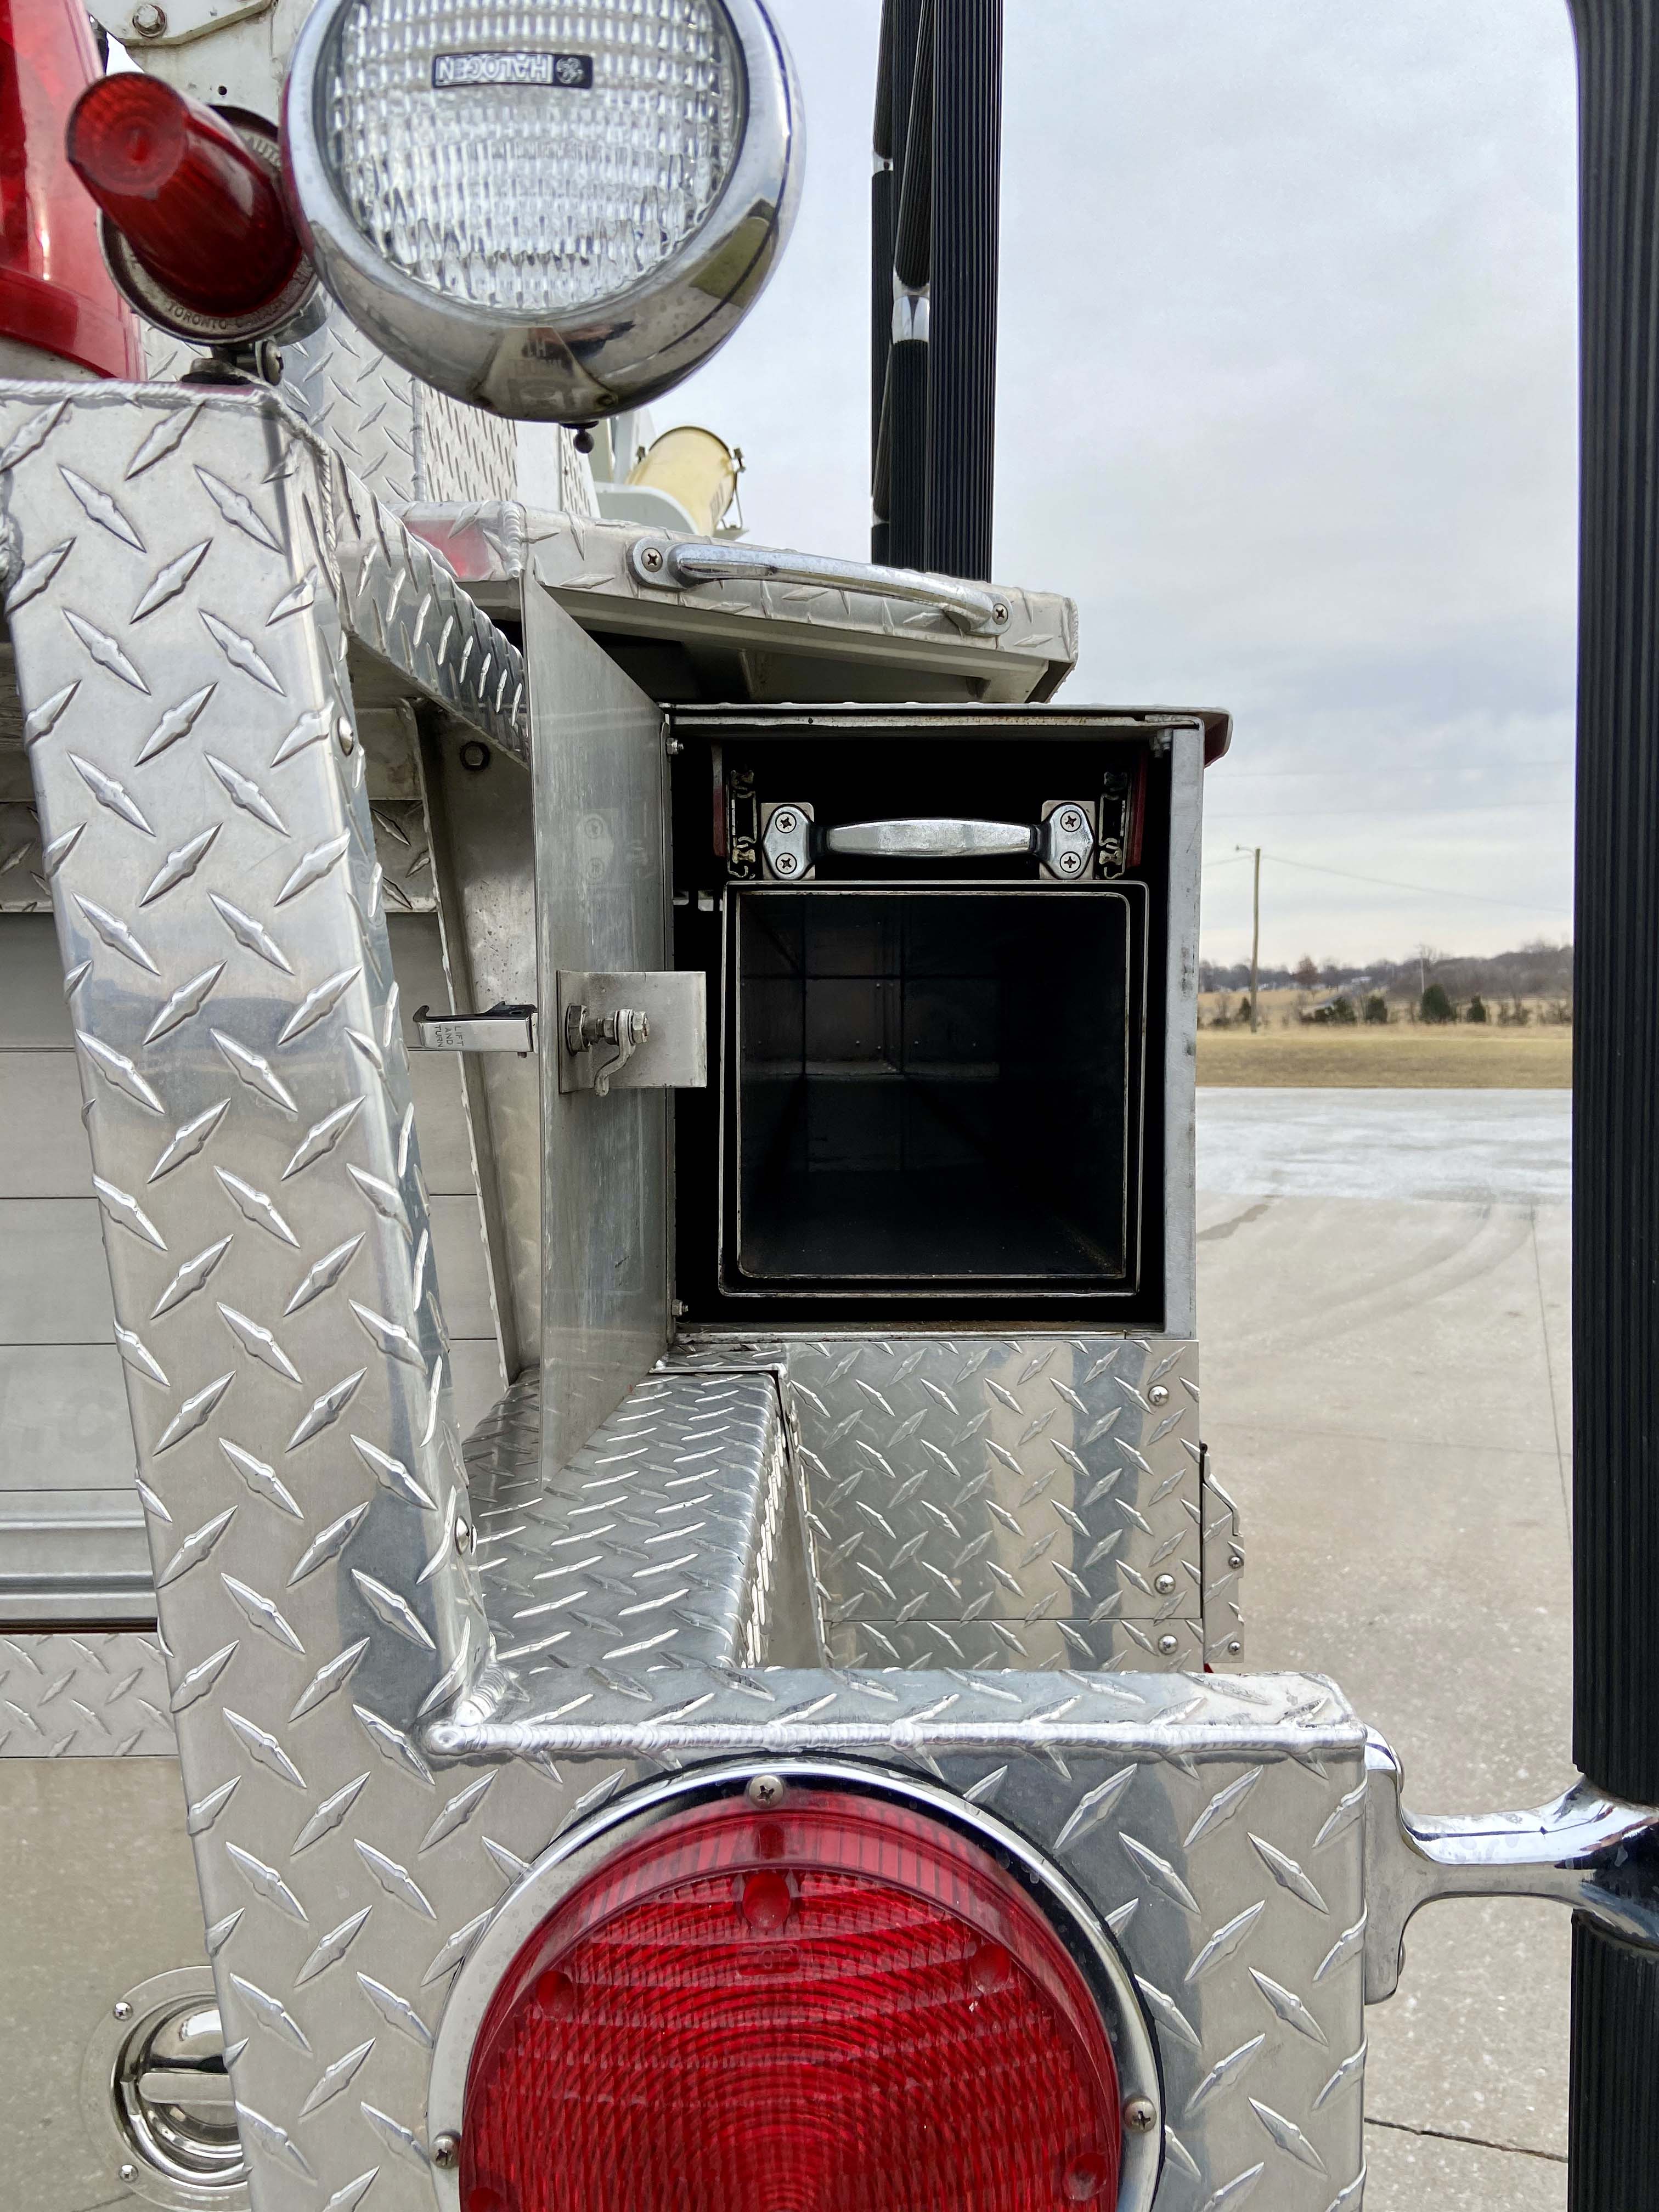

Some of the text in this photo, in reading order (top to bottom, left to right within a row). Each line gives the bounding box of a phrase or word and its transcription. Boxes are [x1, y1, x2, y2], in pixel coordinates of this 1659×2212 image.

[438, 56, 547, 81] HALOGEN
[166, 303, 227, 330] TORONTO
[435, 1025, 443, 1047] TURN
[454, 1026, 464, 1046] LIFT
